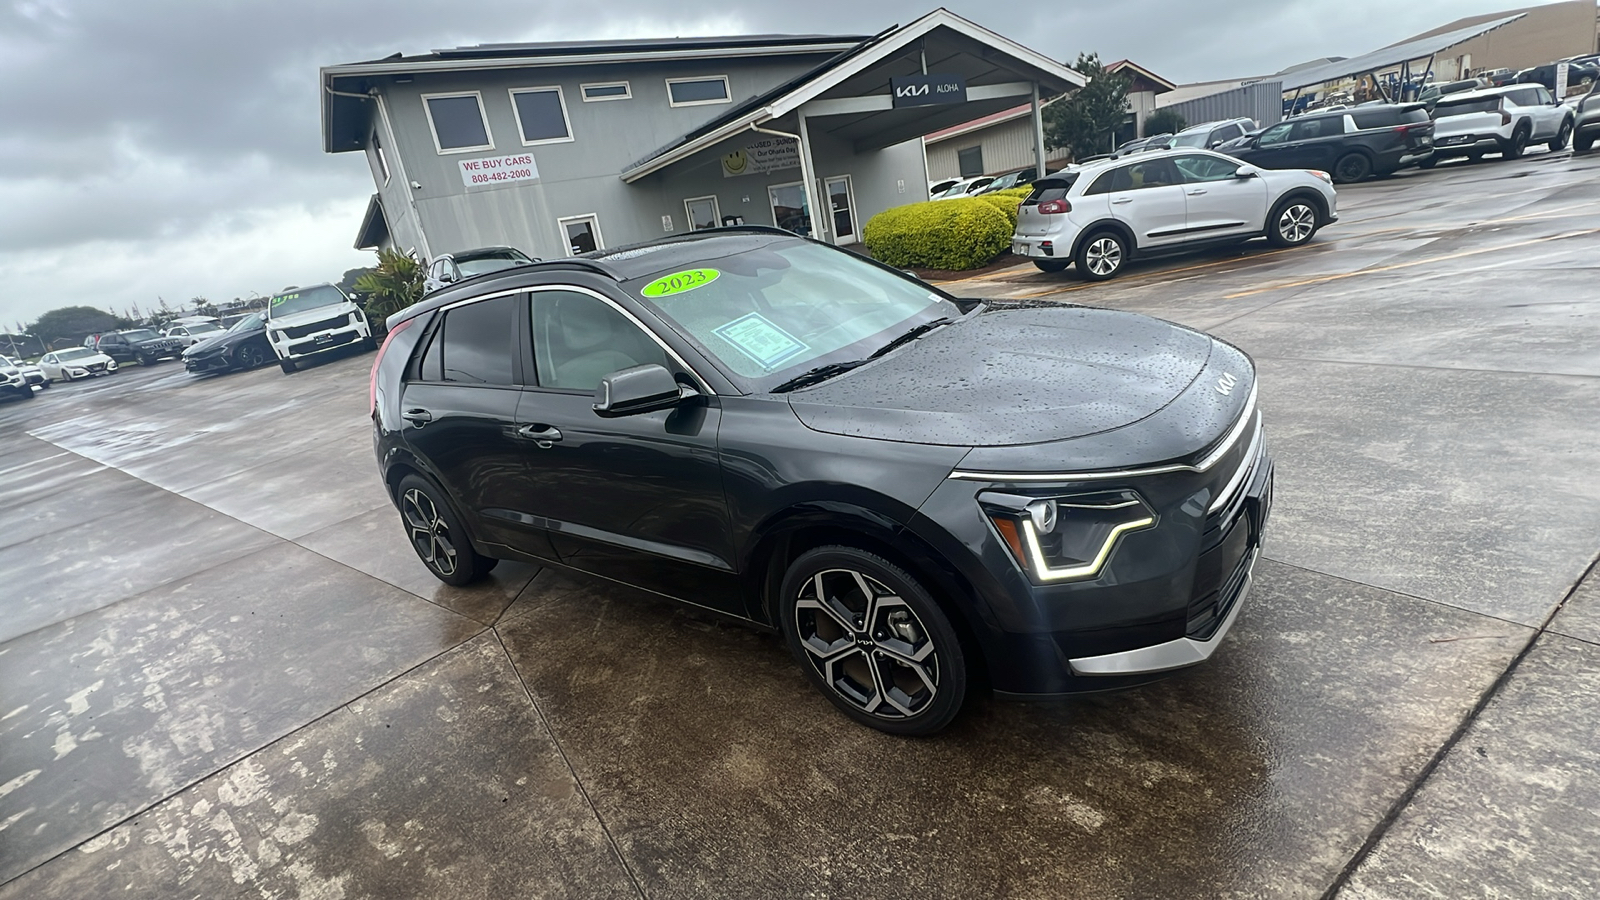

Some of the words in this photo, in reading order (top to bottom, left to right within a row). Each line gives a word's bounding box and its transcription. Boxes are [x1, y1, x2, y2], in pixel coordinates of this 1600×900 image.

[896, 84, 929, 98] KIA
[936, 83, 959, 93] ALOHA
[747, 140, 771, 150] OSED
[776, 137, 798, 147] SUNDA
[463, 161, 480, 171] WE
[482, 159, 502, 169] BUY
[505, 155, 532, 166] CARS
[472, 169, 531, 183] 808-482-2000
[657, 270, 706, 294] 2023
[1213, 372, 1237, 395] KIA
